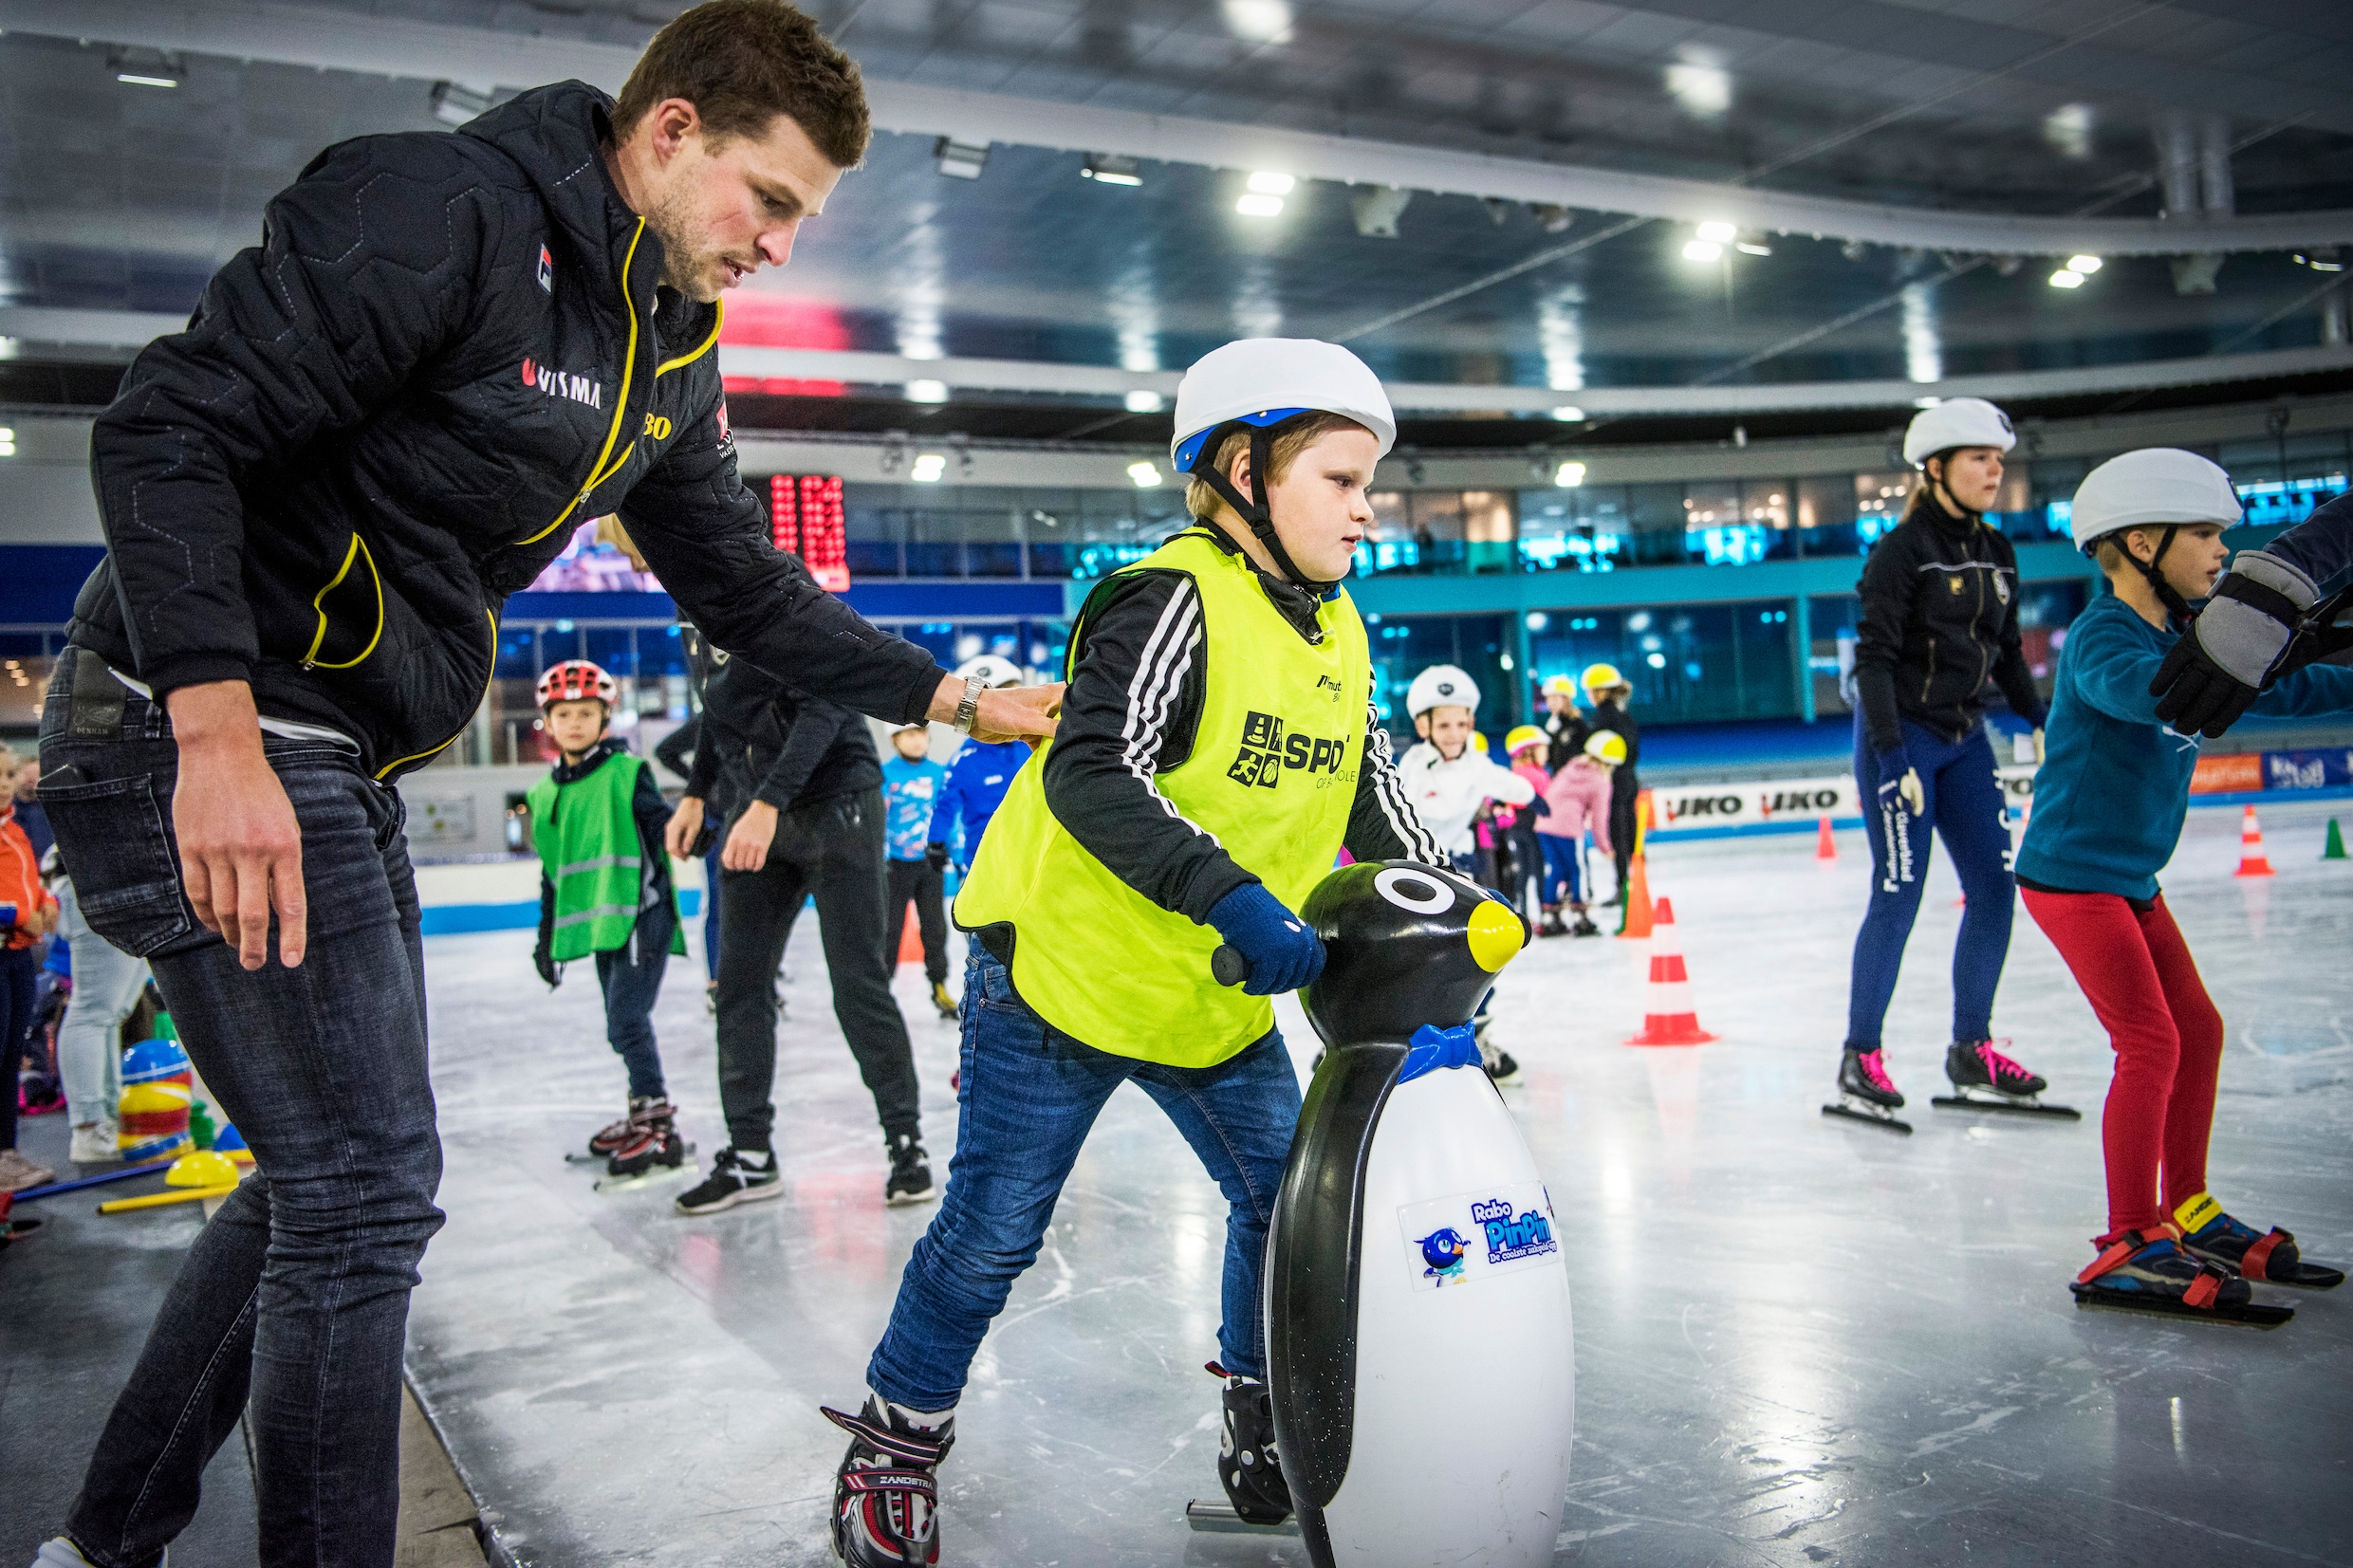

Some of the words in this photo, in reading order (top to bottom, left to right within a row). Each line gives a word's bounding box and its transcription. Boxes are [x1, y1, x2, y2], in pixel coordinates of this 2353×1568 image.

[537, 365, 601, 410] VISMA
[1472, 1199, 1512, 1224] Rabo
[1484, 1209, 1551, 1251] PinPin
[1489, 1251, 1501, 1264] De
[1501, 1246, 1527, 1261] coolste
[880, 1476, 934, 1489] ZANDSTRA
